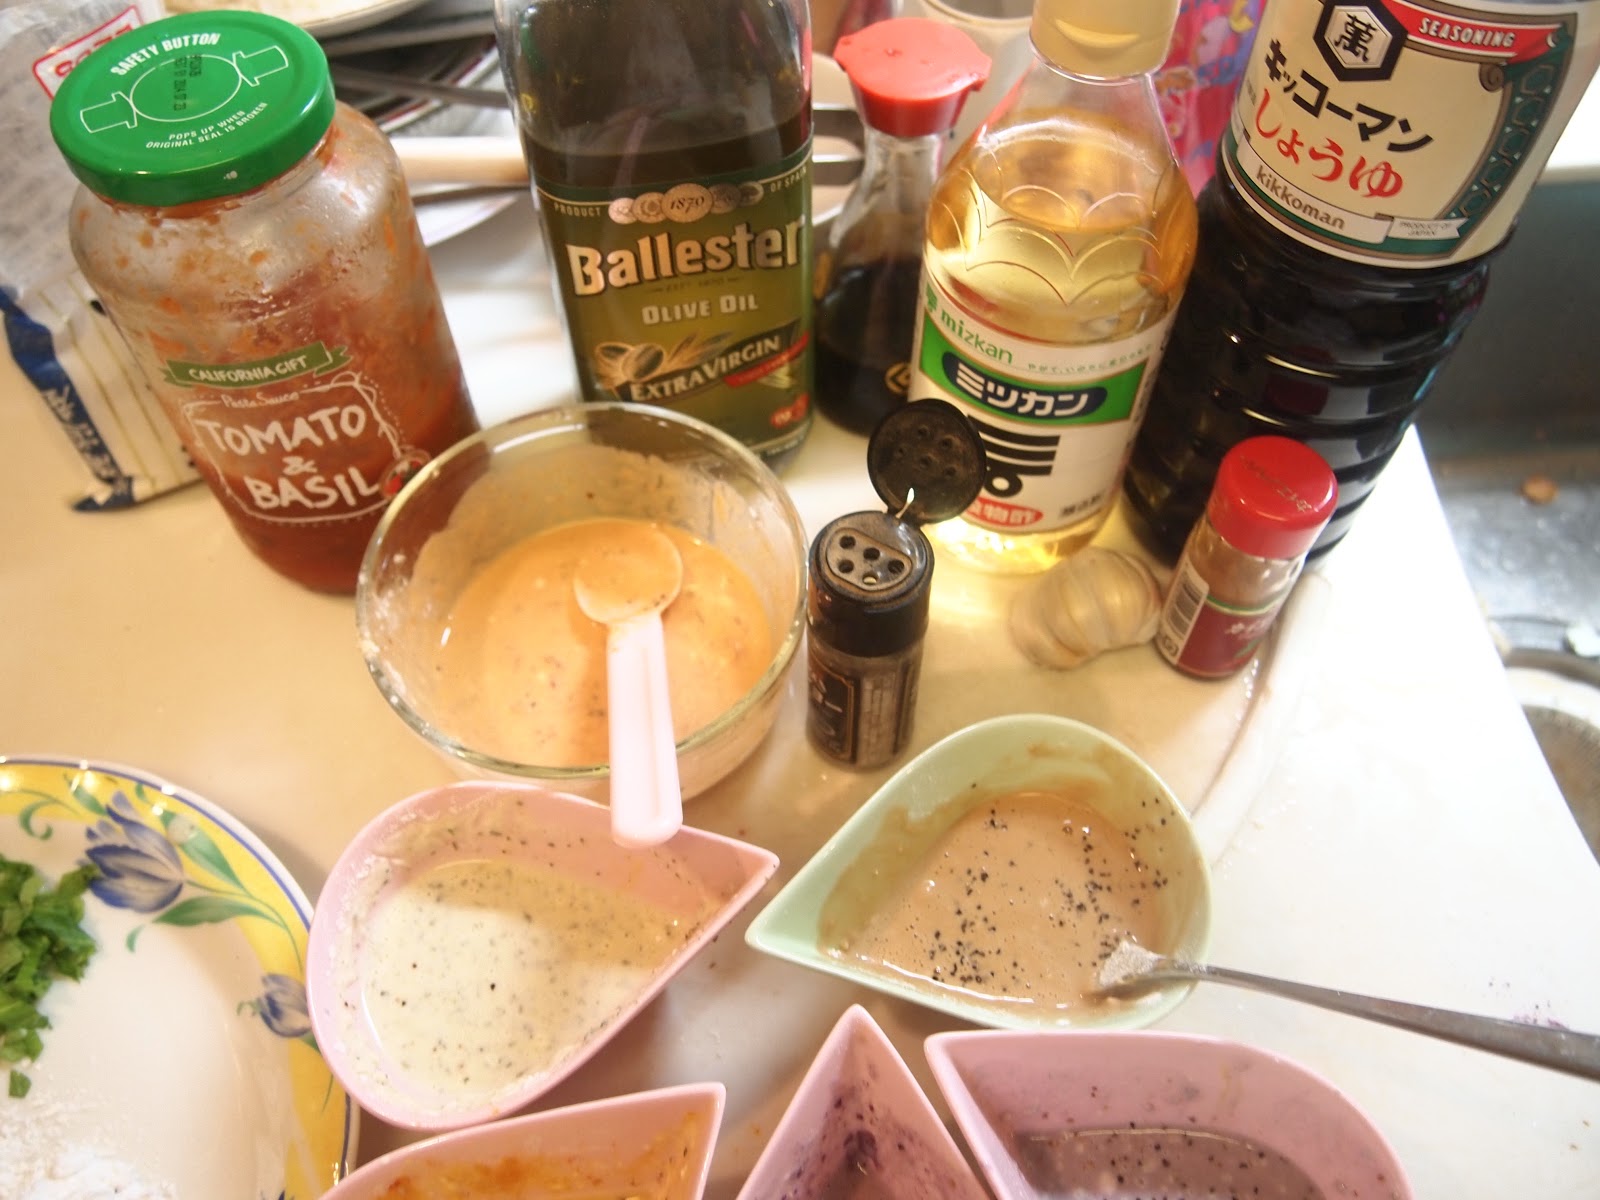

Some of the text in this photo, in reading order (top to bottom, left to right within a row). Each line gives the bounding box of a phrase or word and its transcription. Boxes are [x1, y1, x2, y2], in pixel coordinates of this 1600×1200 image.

[110, 44, 159, 75] SAFETY
[161, 32, 221, 52] BUTTON
[1418, 17, 1516, 48] SEASONING
[1265, 38, 1434, 153] キッコーマン
[145, 102, 268, 149] ORIGINAL SEAL IS BROKEN
[168, 110, 246, 141] POPS UP WHEN
[1255, 88, 1404, 199] しょうゆ
[553, 201, 601, 217] PRODUCT
[670, 196, 705, 214] 1870
[1256, 165, 1346, 230] kikkoman
[565, 213, 806, 296] Ballester
[641, 293, 759, 325] OLIVE OIL
[941, 308, 1013, 365] mizkan
[188, 354, 307, 383] CALIFORNIA GIFT
[956, 361, 1089, 418] ミツカン
[191, 404, 366, 456] TOMATO
[243, 466, 382, 510] BASIL
[282, 456, 317, 476] &
